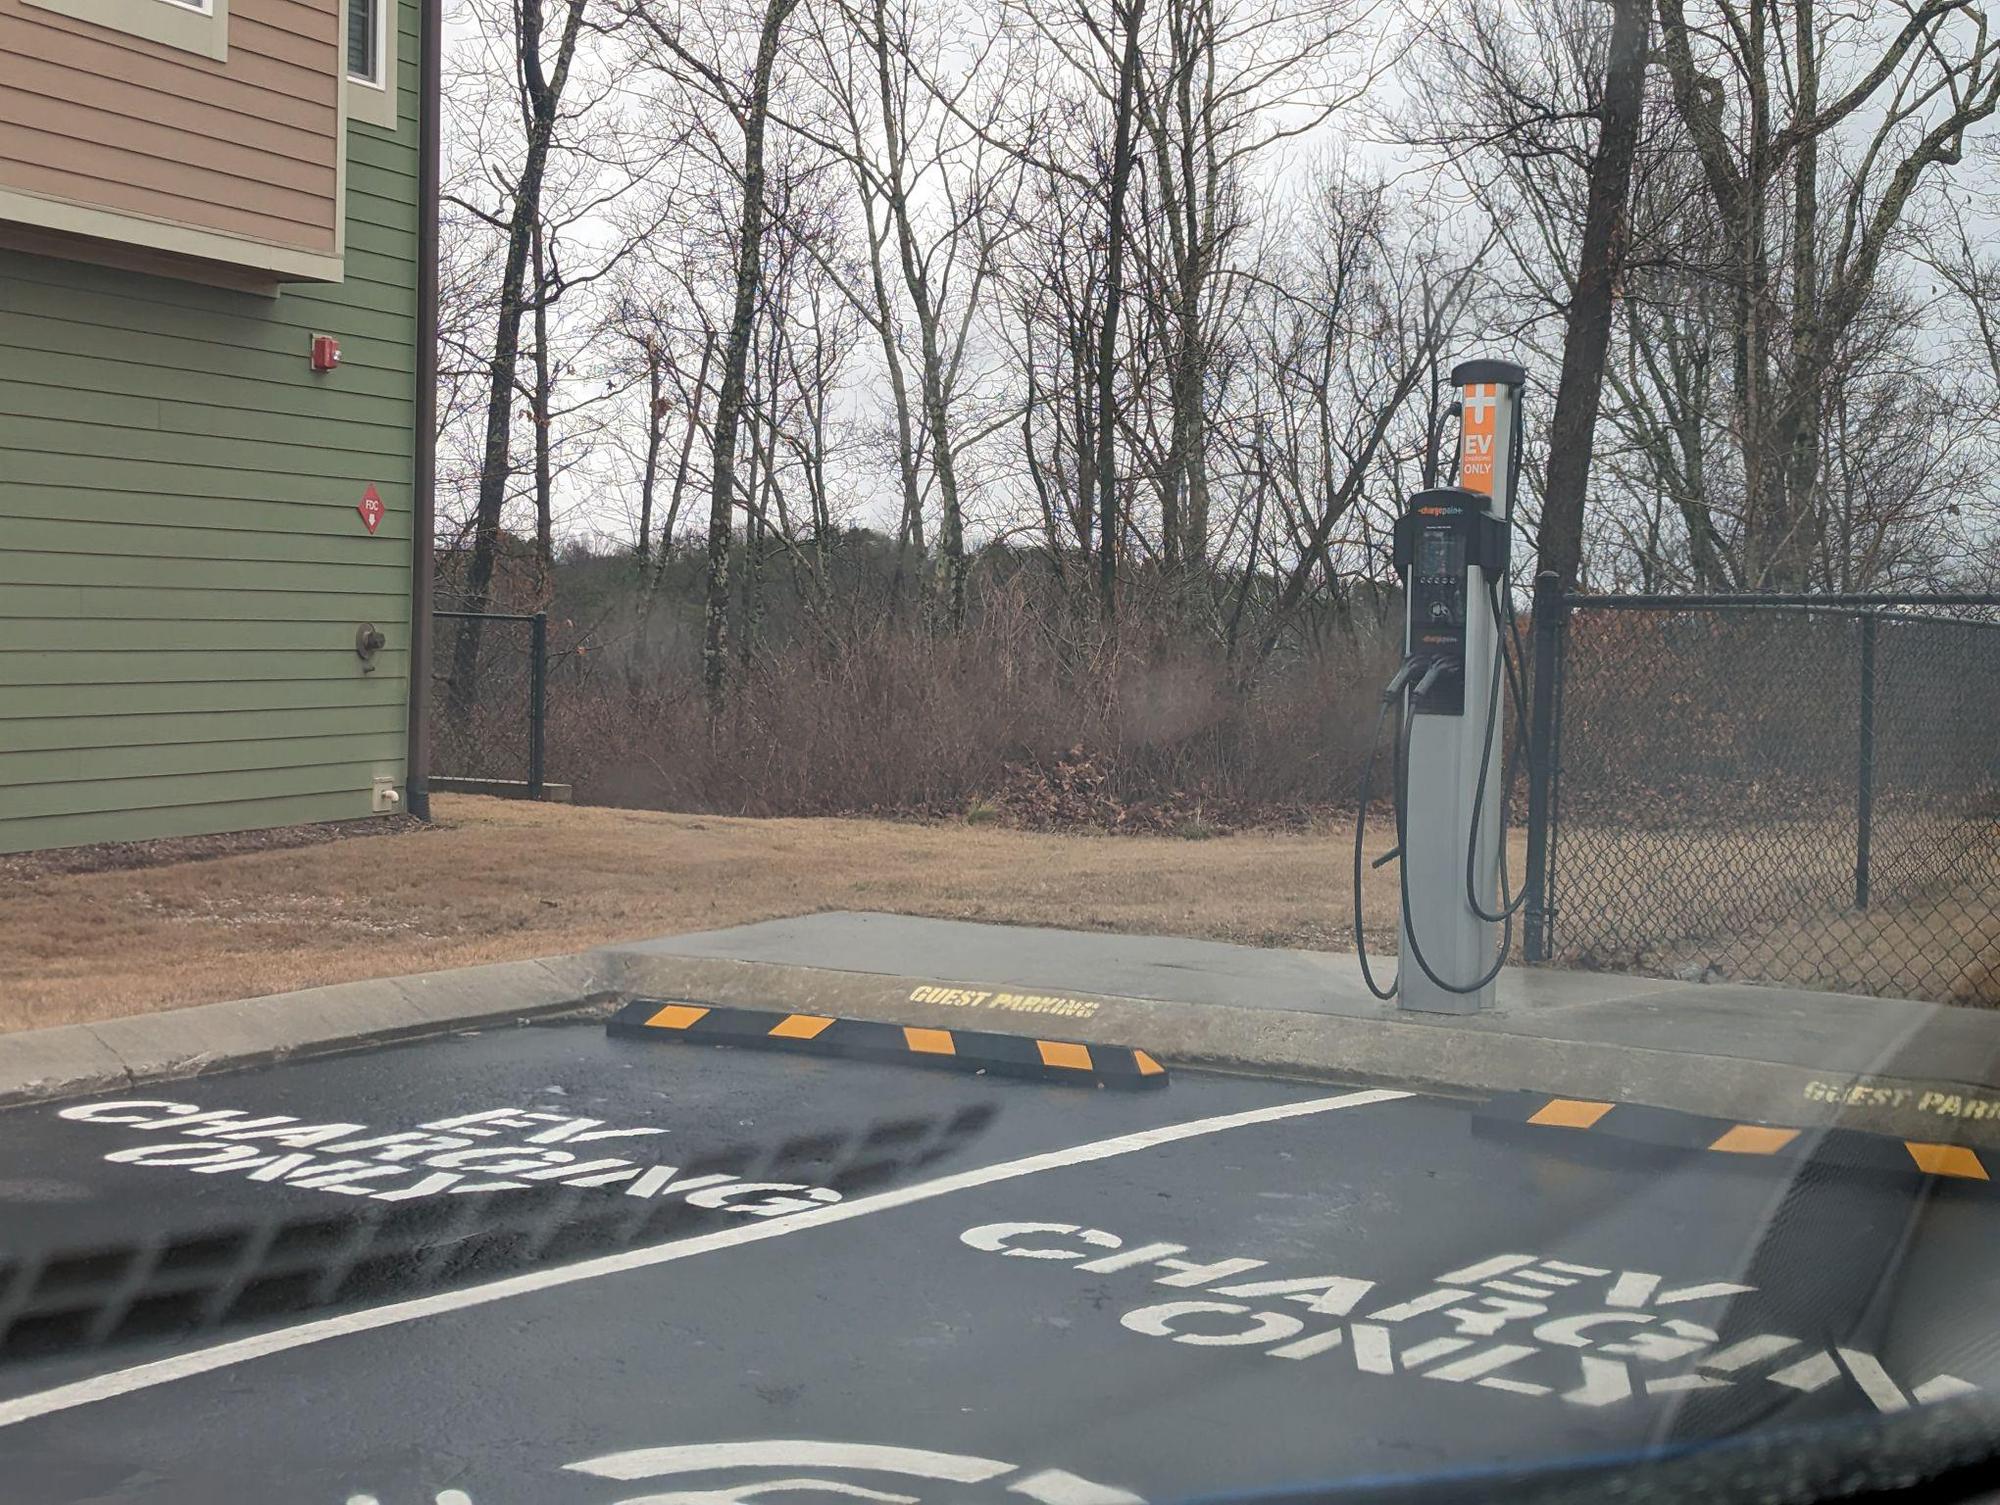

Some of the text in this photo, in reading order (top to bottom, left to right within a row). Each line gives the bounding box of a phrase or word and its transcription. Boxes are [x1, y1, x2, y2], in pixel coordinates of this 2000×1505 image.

[1465, 434, 1493, 454] EV
[1464, 463, 1491, 474] ONLY
[365, 499, 379, 511] FDC
[909, 985, 1100, 1018] GUEST PARKING
[1918, 1090, 2000, 1120] PARK
[417, 1108, 671, 1143] EV
[58, 1101, 843, 1216] CHARGING
[104, 1142, 533, 1201] ONLY
[1434, 1255, 1759, 1308] EV
[960, 1222, 1980, 1413] CHARGIN
[1120, 1301, 1737, 1406] ONLY
